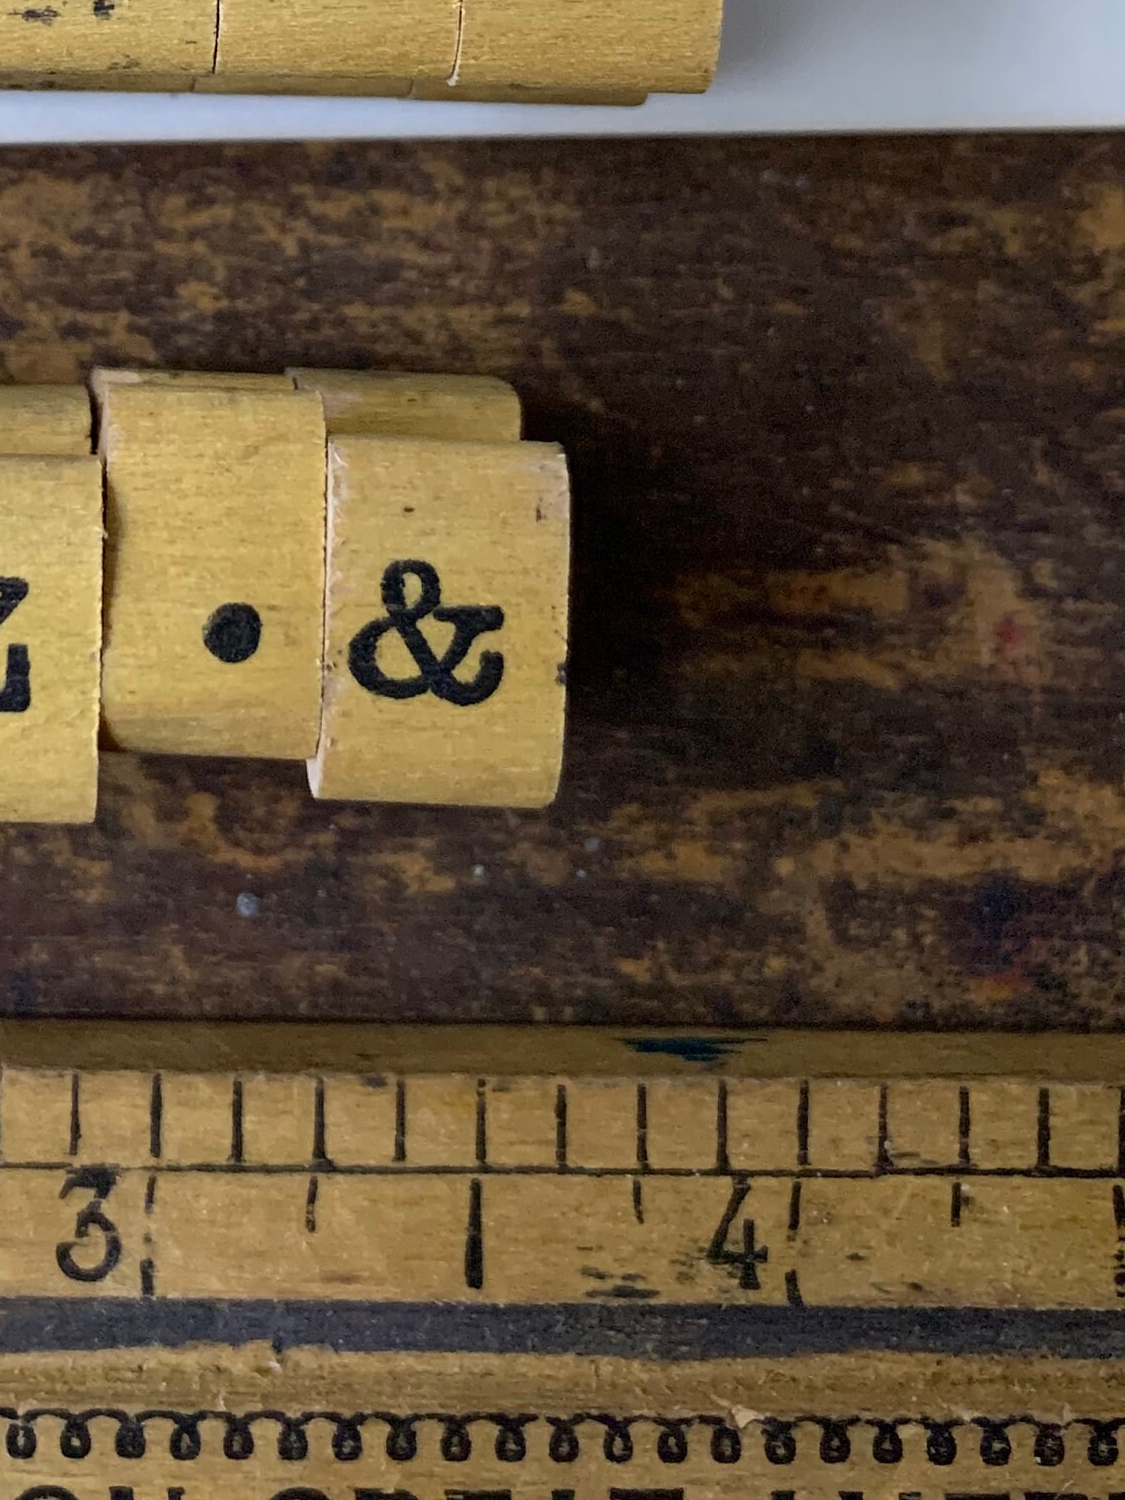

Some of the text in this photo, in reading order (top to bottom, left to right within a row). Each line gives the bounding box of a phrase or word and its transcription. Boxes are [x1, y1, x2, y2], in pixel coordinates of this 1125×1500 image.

[348, 560, 505, 707] &
[56, 1164, 122, 1282] 3
[706, 1173, 769, 1290] 4
